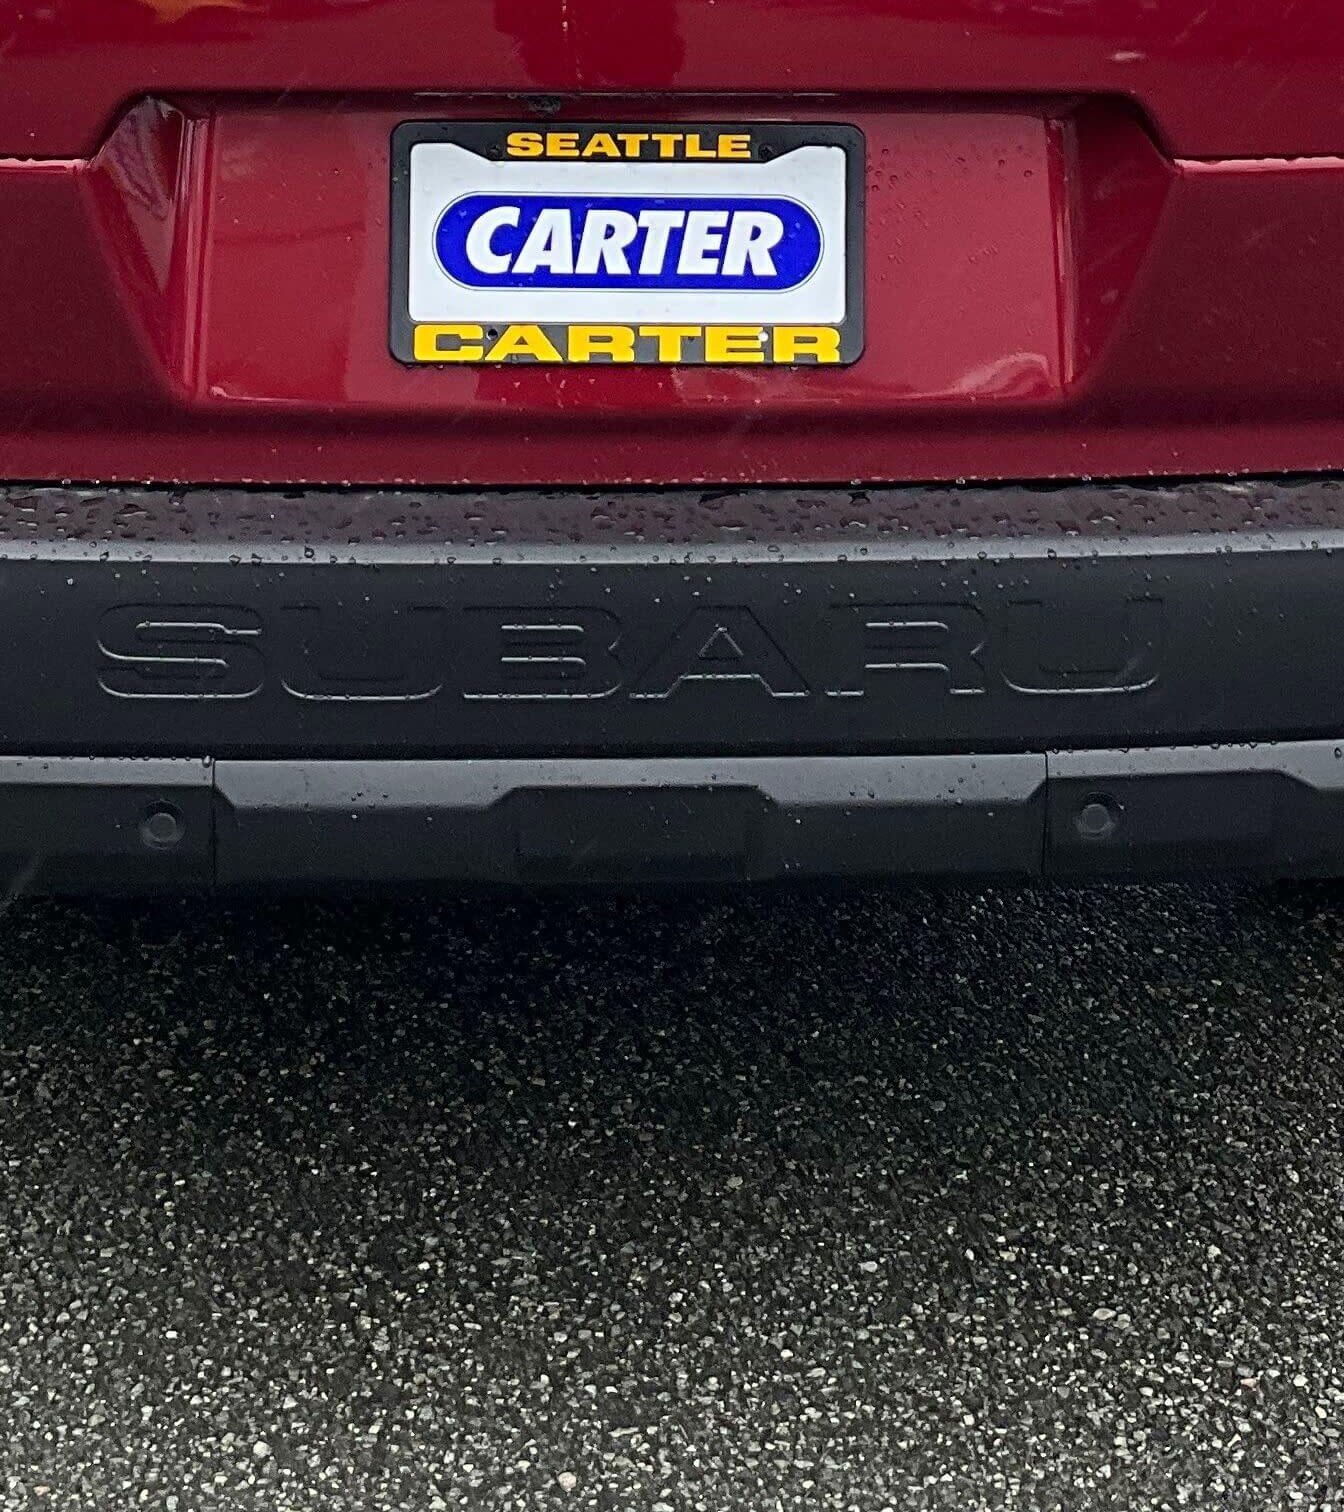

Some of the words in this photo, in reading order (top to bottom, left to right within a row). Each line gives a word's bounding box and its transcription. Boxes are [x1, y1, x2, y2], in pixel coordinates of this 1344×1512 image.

[506, 131, 752, 159] SEATTLE
[464, 205, 785, 277] CARTER
[413, 323, 841, 364] CARTER
[96, 599, 1166, 701] SUBARU
